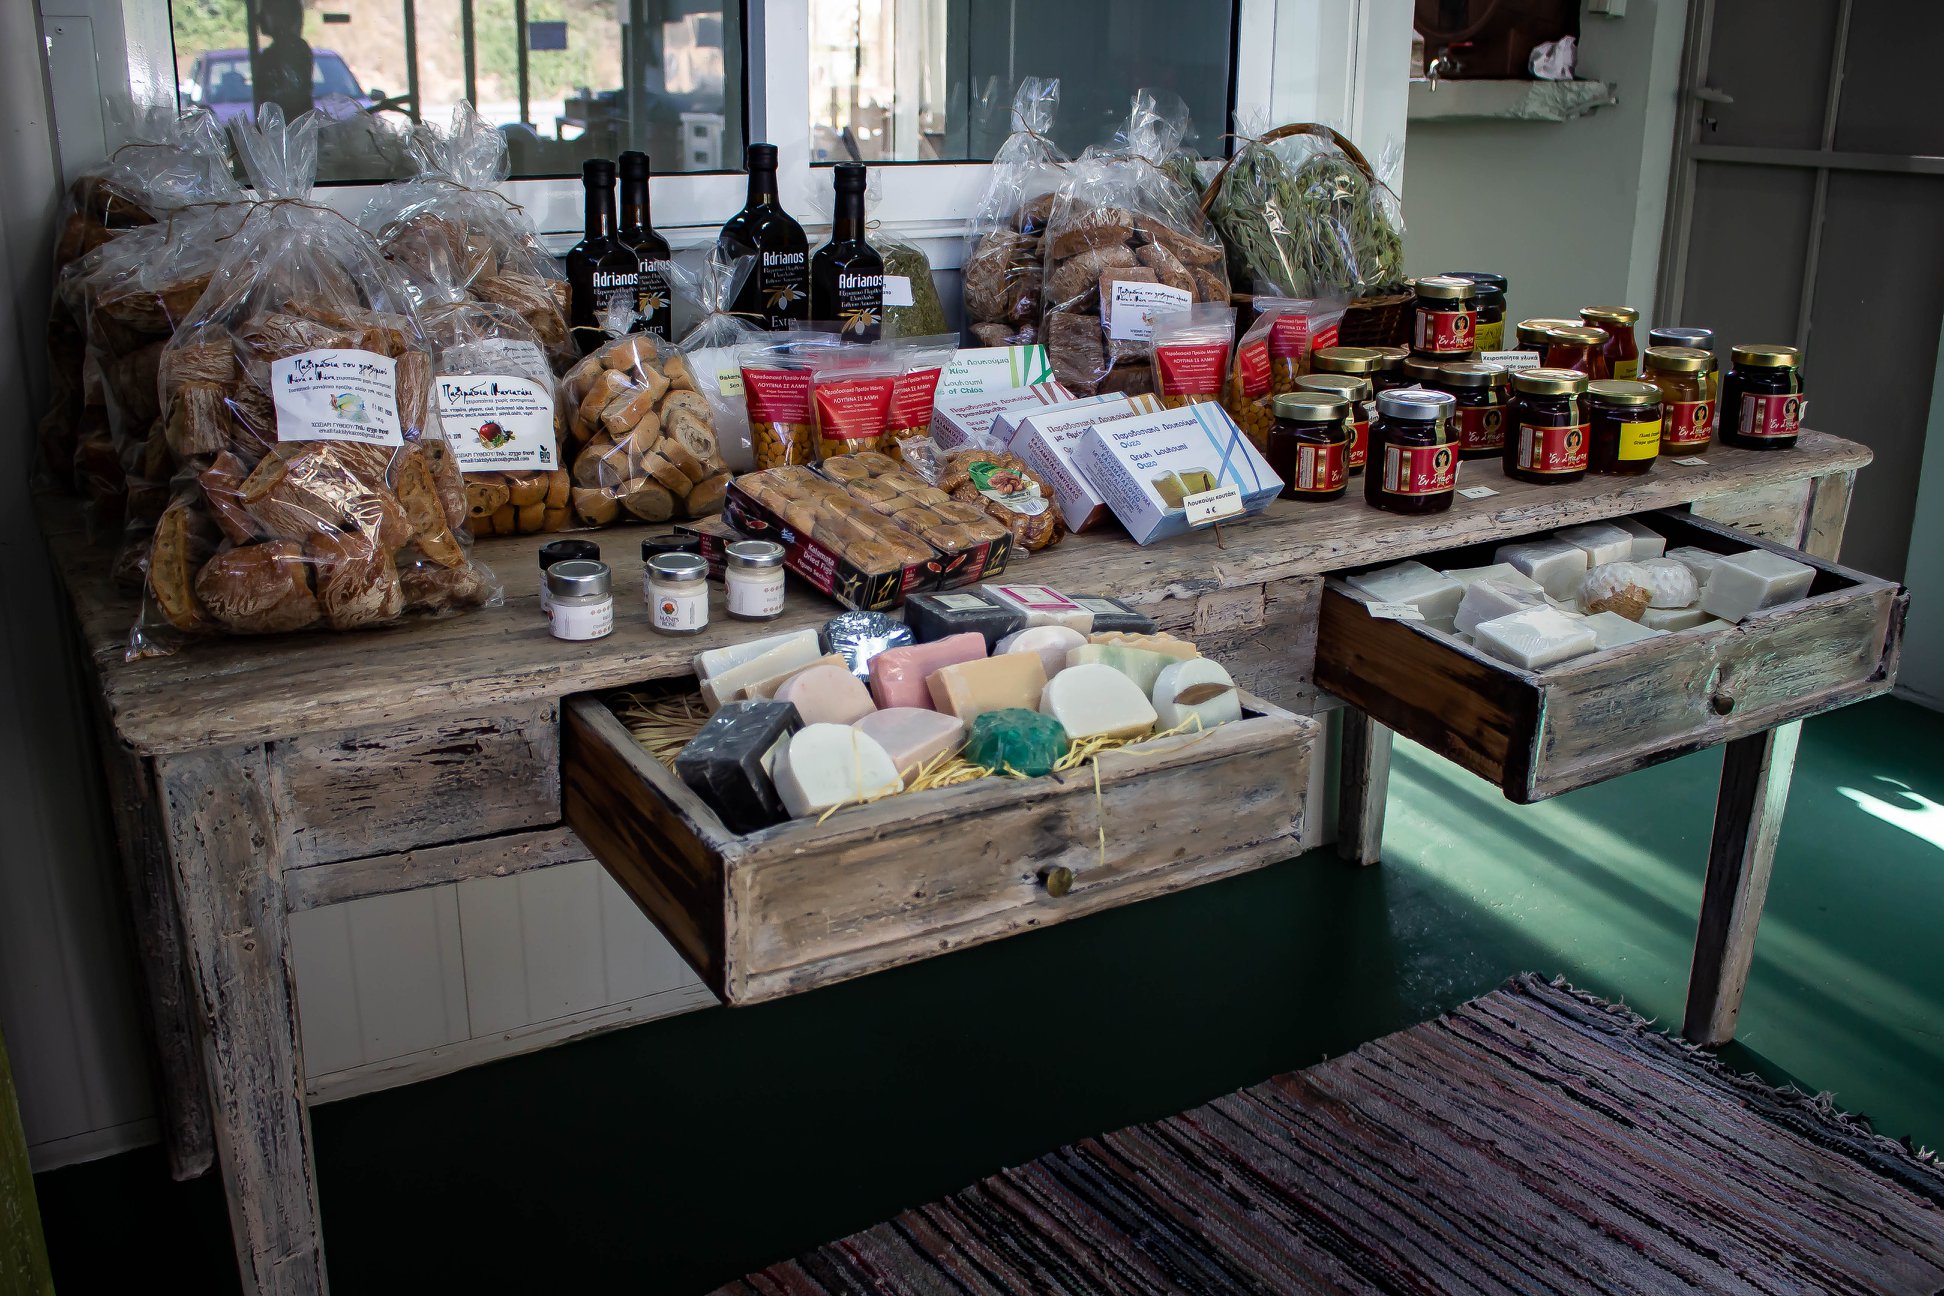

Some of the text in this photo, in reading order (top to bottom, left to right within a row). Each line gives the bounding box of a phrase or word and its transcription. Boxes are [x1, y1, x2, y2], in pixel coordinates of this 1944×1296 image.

[640, 259, 671, 273] rianos
[764, 251, 805, 266] Adrianos
[593, 272, 639, 288] Adrianos
[839, 273, 883, 289] Adrianos
[1482, 354, 1520, 362] Χειροποίητα
[442, 381, 489, 405] Παξιμάδια
[948, 387, 957, 395] of
[833, 396, 857, 404] ΛΟΥΠΙΝΑ
[1112, 425, 1161, 441] Παραδοσιακά
[1187, 496, 1216, 507] Λουκούμι
[801, 550, 821, 568] Dried
